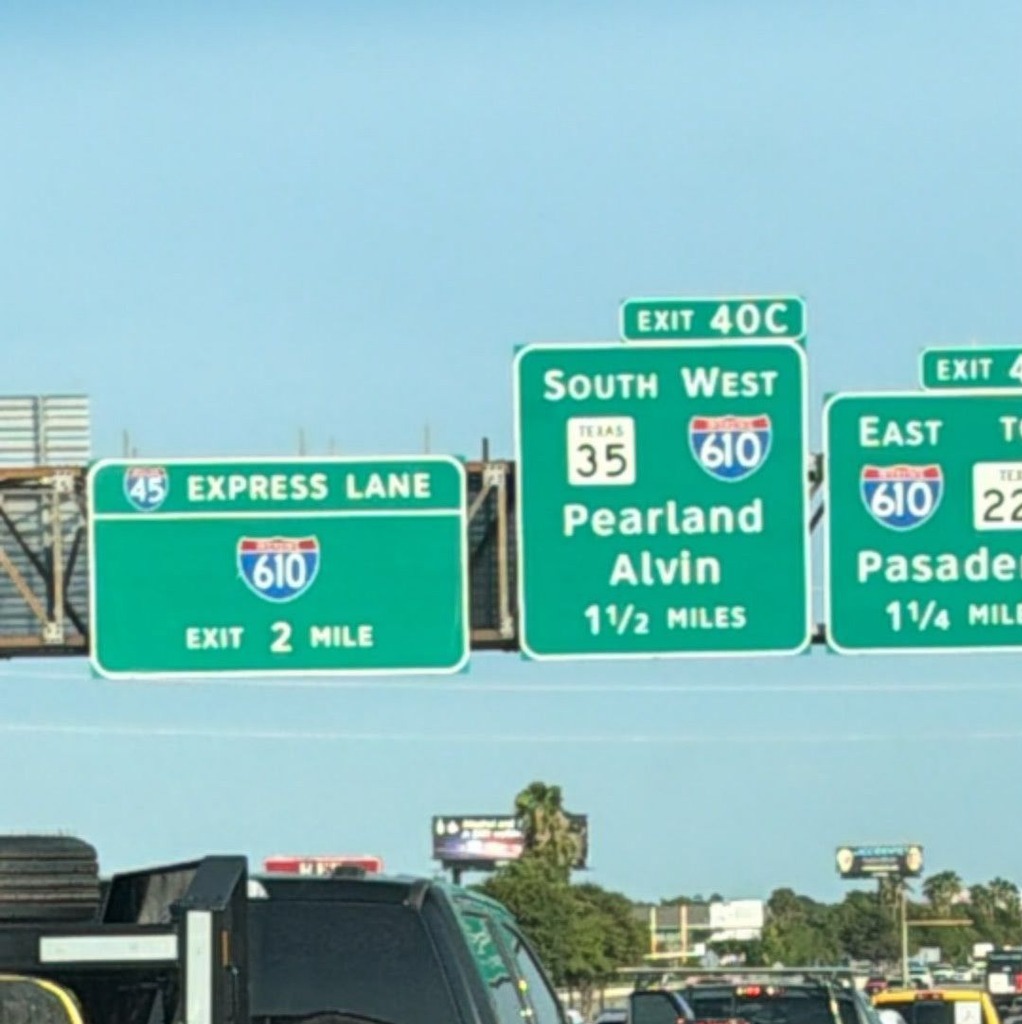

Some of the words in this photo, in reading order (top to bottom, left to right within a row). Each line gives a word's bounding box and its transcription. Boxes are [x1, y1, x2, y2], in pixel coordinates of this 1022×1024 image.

[637, 309, 694, 332] EXIT
[710, 304, 789, 334] 40C
[544, 369, 658, 401] SOUTH
[681, 367, 778, 397] WEST
[937, 357, 992, 380] EXIT
[580, 425, 624, 438] TEXAS
[859, 416, 942, 447] EAST
[577, 443, 627, 477] 35
[700, 432, 761, 468] 610
[130, 476, 165, 503] 45
[188, 473, 328, 501] EXPRESS
[346, 472, 430, 499] LANE
[871, 482, 933, 517] 610
[564, 498, 763, 536] Pearland
[253, 553, 306, 589] 610
[610, 550, 720, 585] Alvin
[667, 606, 746, 628] MILES
[186, 626, 244, 649] EXIT
[271, 621, 292, 653] 2
[310, 625, 373, 647] MILE
